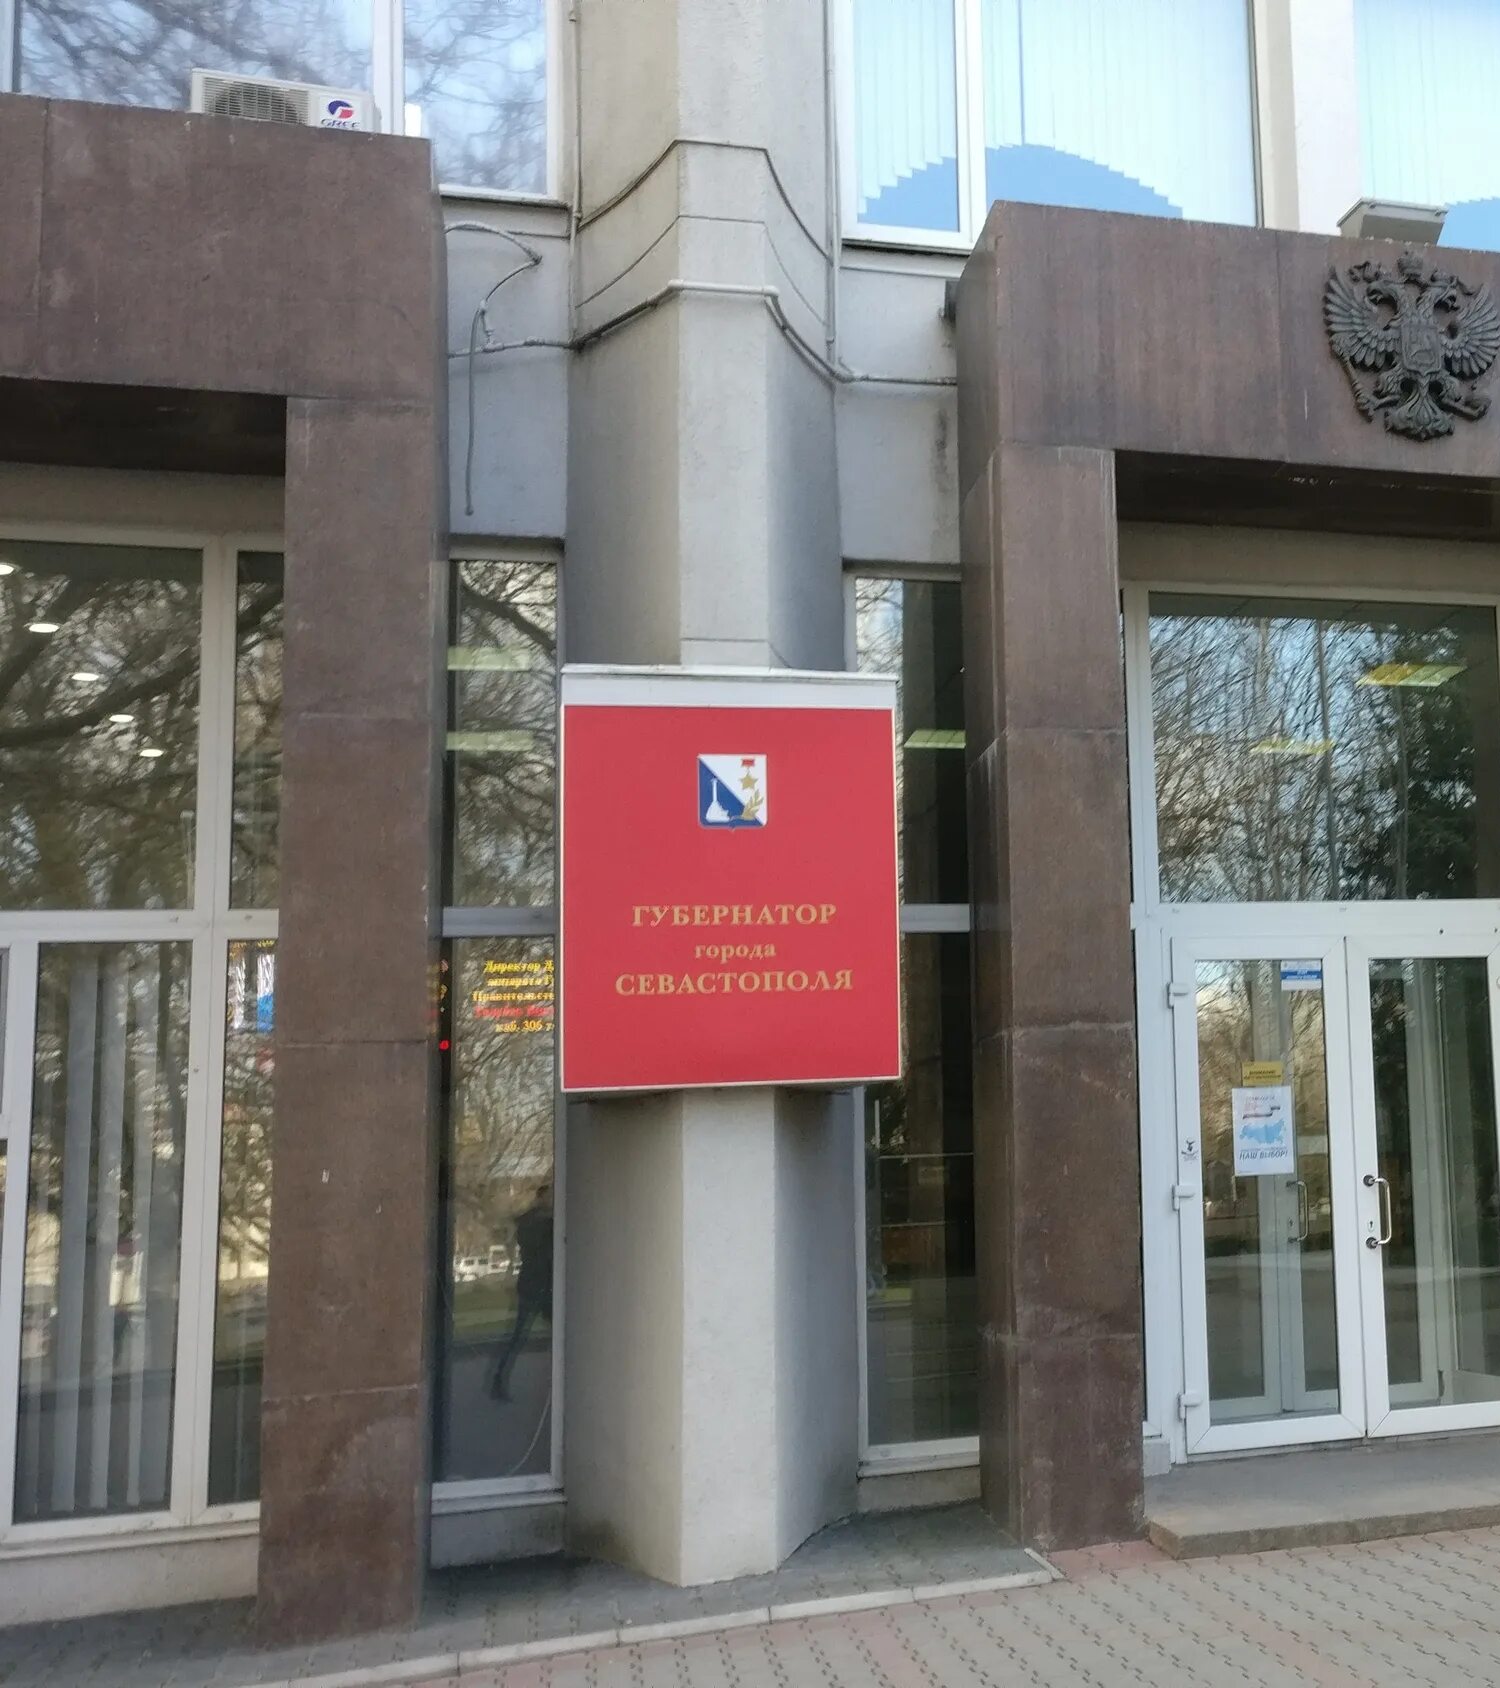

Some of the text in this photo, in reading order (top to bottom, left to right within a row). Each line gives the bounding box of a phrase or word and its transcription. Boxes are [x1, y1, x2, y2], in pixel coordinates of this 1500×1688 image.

[632, 903, 837, 928] ГУБЕРНАТОР
[694, 942, 777, 964] города
[614, 969, 853, 996] СЕВАСТОПОЛЯ
